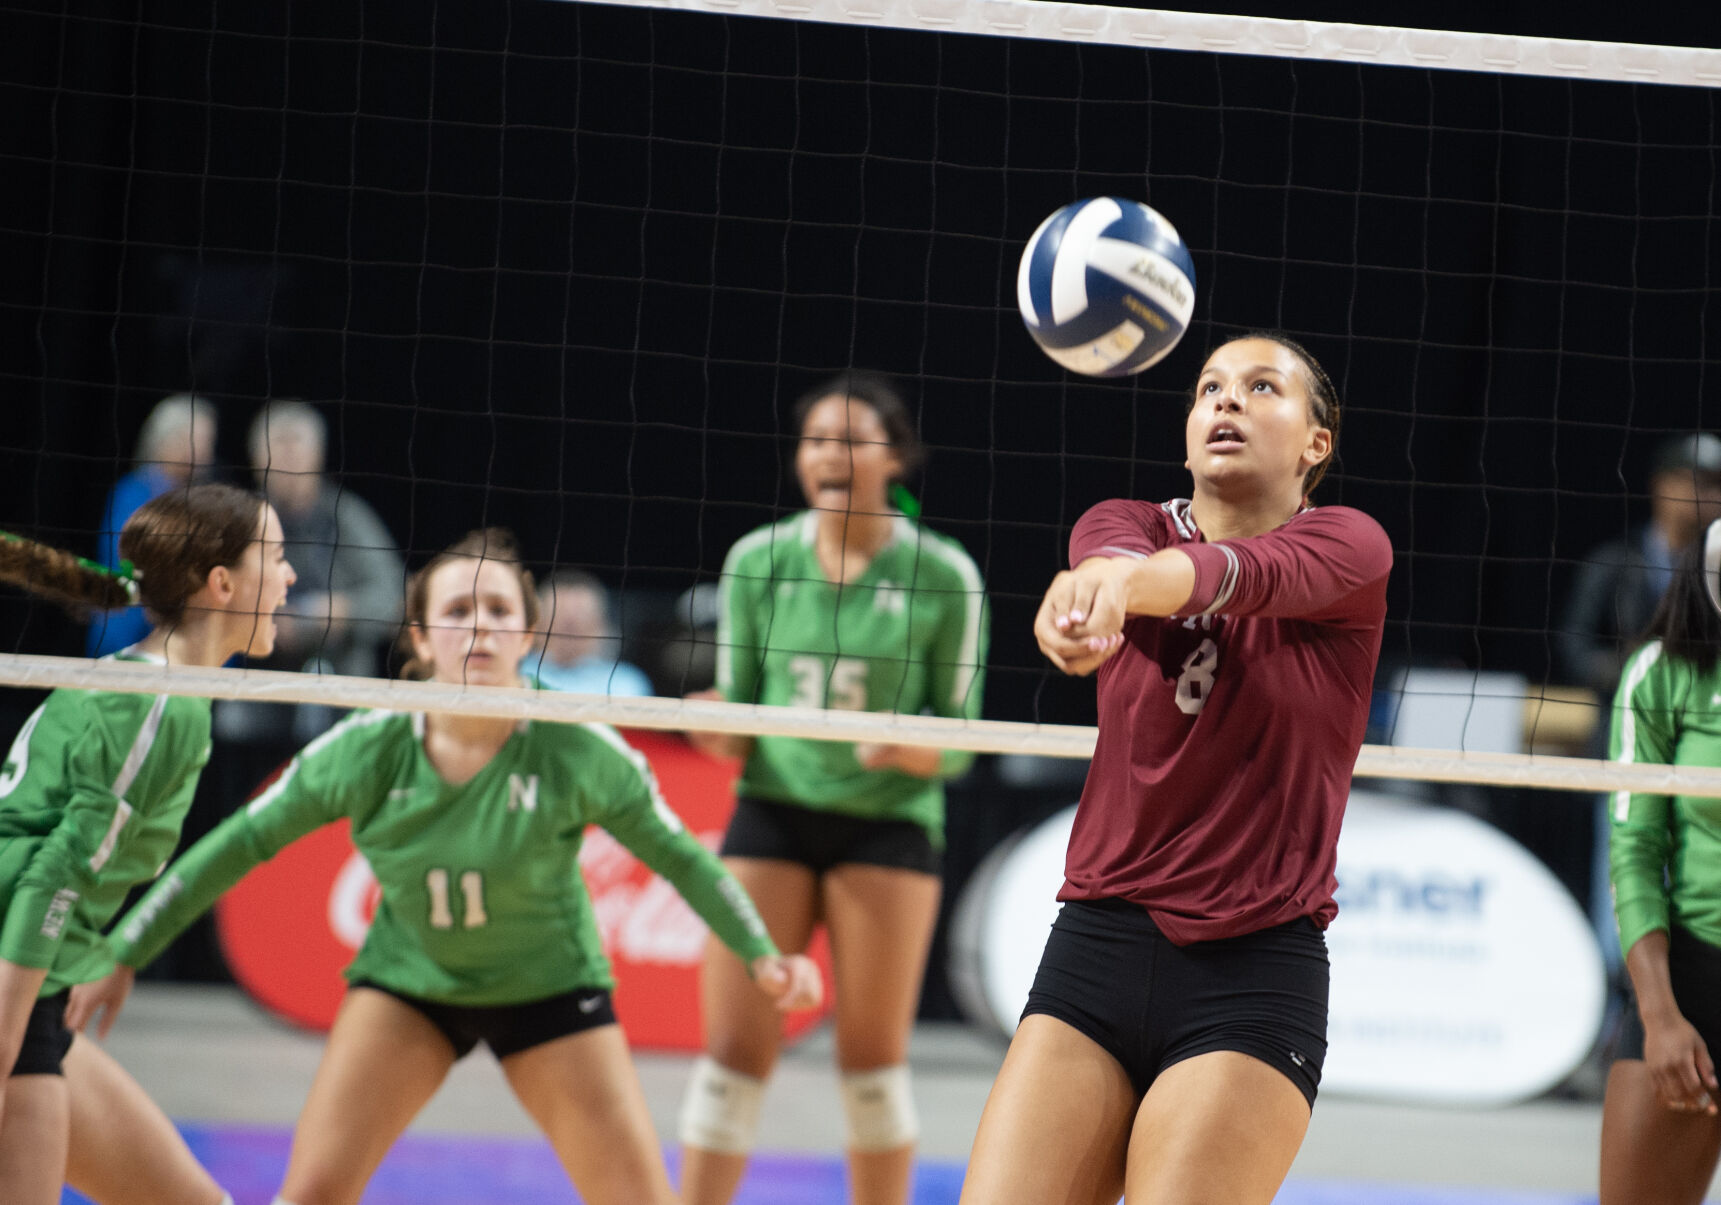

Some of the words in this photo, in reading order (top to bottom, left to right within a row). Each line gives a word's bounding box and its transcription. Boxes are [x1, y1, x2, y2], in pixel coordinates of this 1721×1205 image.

[788, 656, 869, 711] 35
[1174, 638, 1218, 715] 8
[507, 772, 541, 813] N
[426, 868, 488, 929] 11
